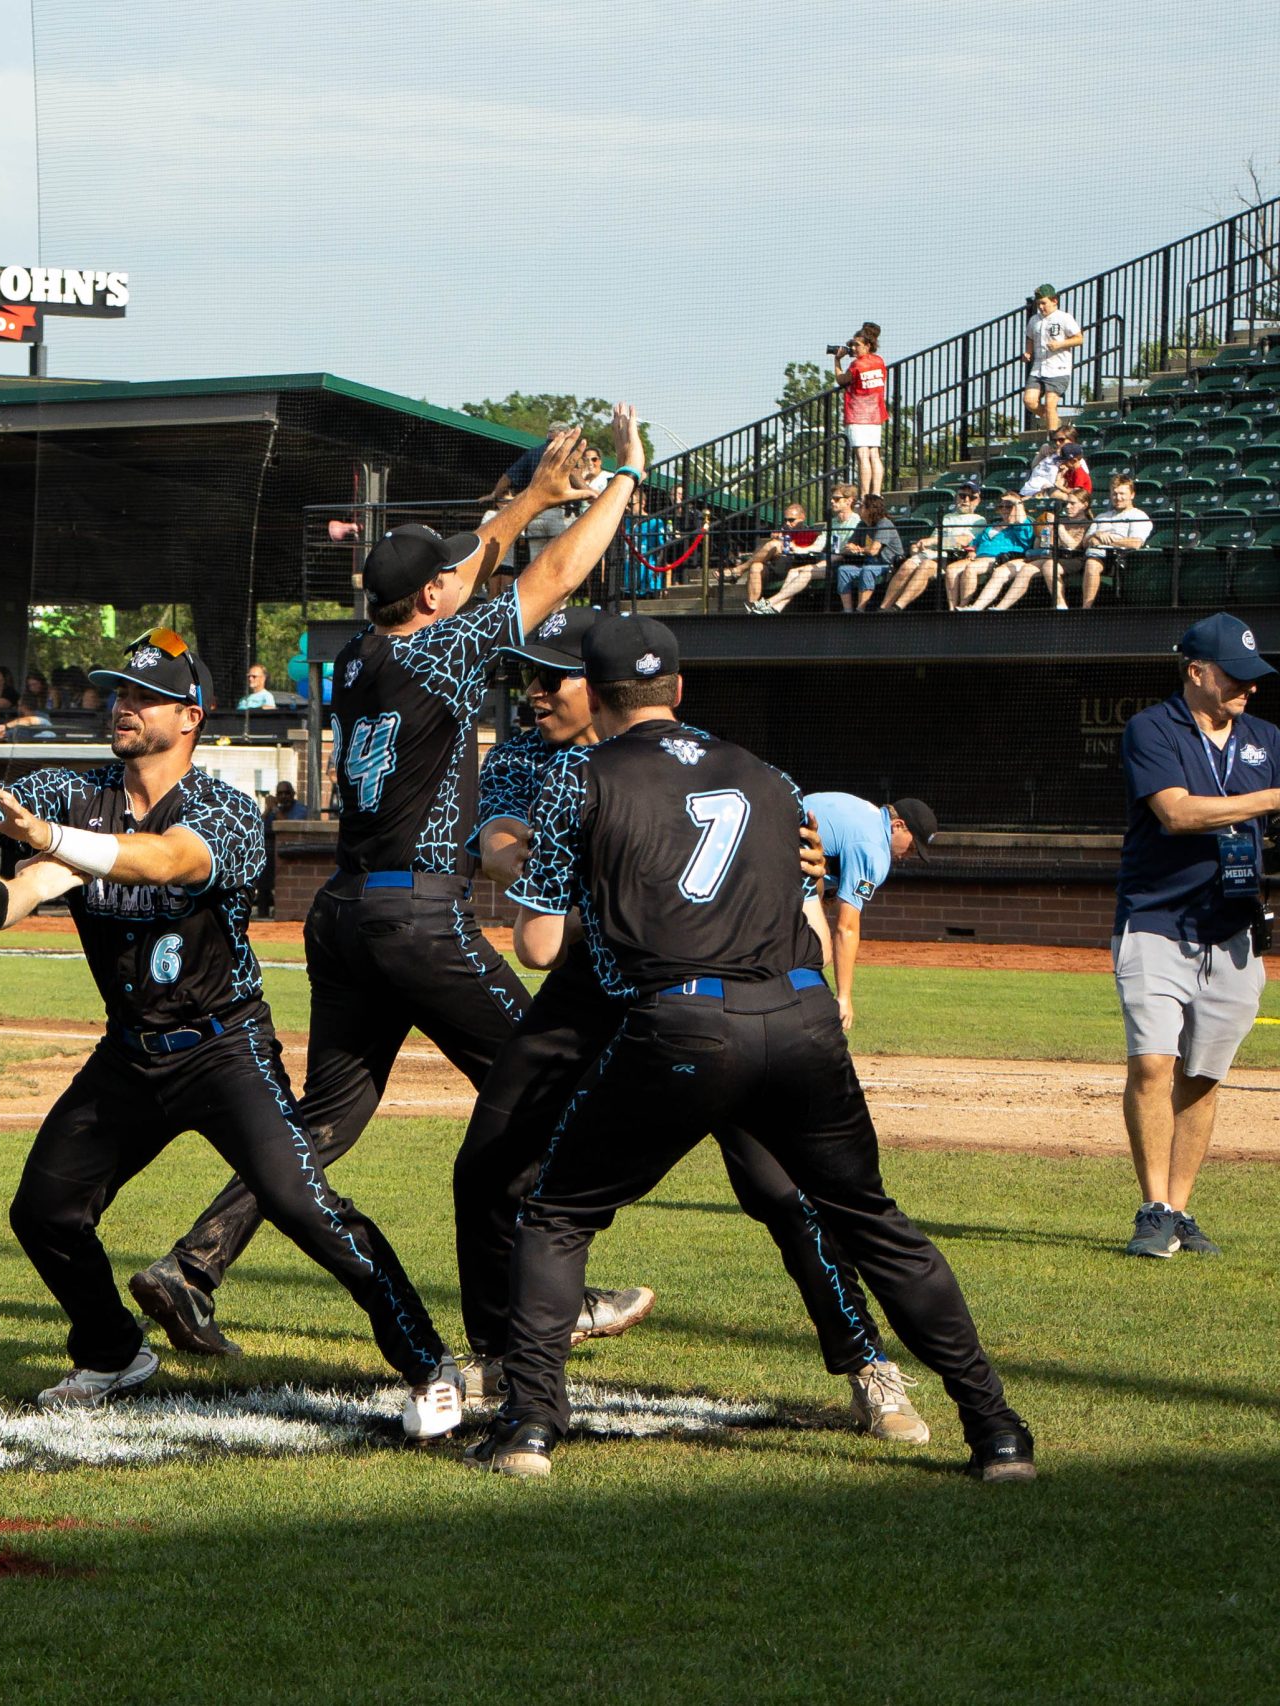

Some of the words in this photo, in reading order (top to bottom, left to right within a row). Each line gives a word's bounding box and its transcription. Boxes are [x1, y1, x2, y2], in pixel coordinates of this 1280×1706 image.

[1084, 738, 1115, 754] FINE
[677, 788, 751, 904] 7
[1225, 868, 1255, 879] MEDIA
[150, 933, 183, 984] 6
